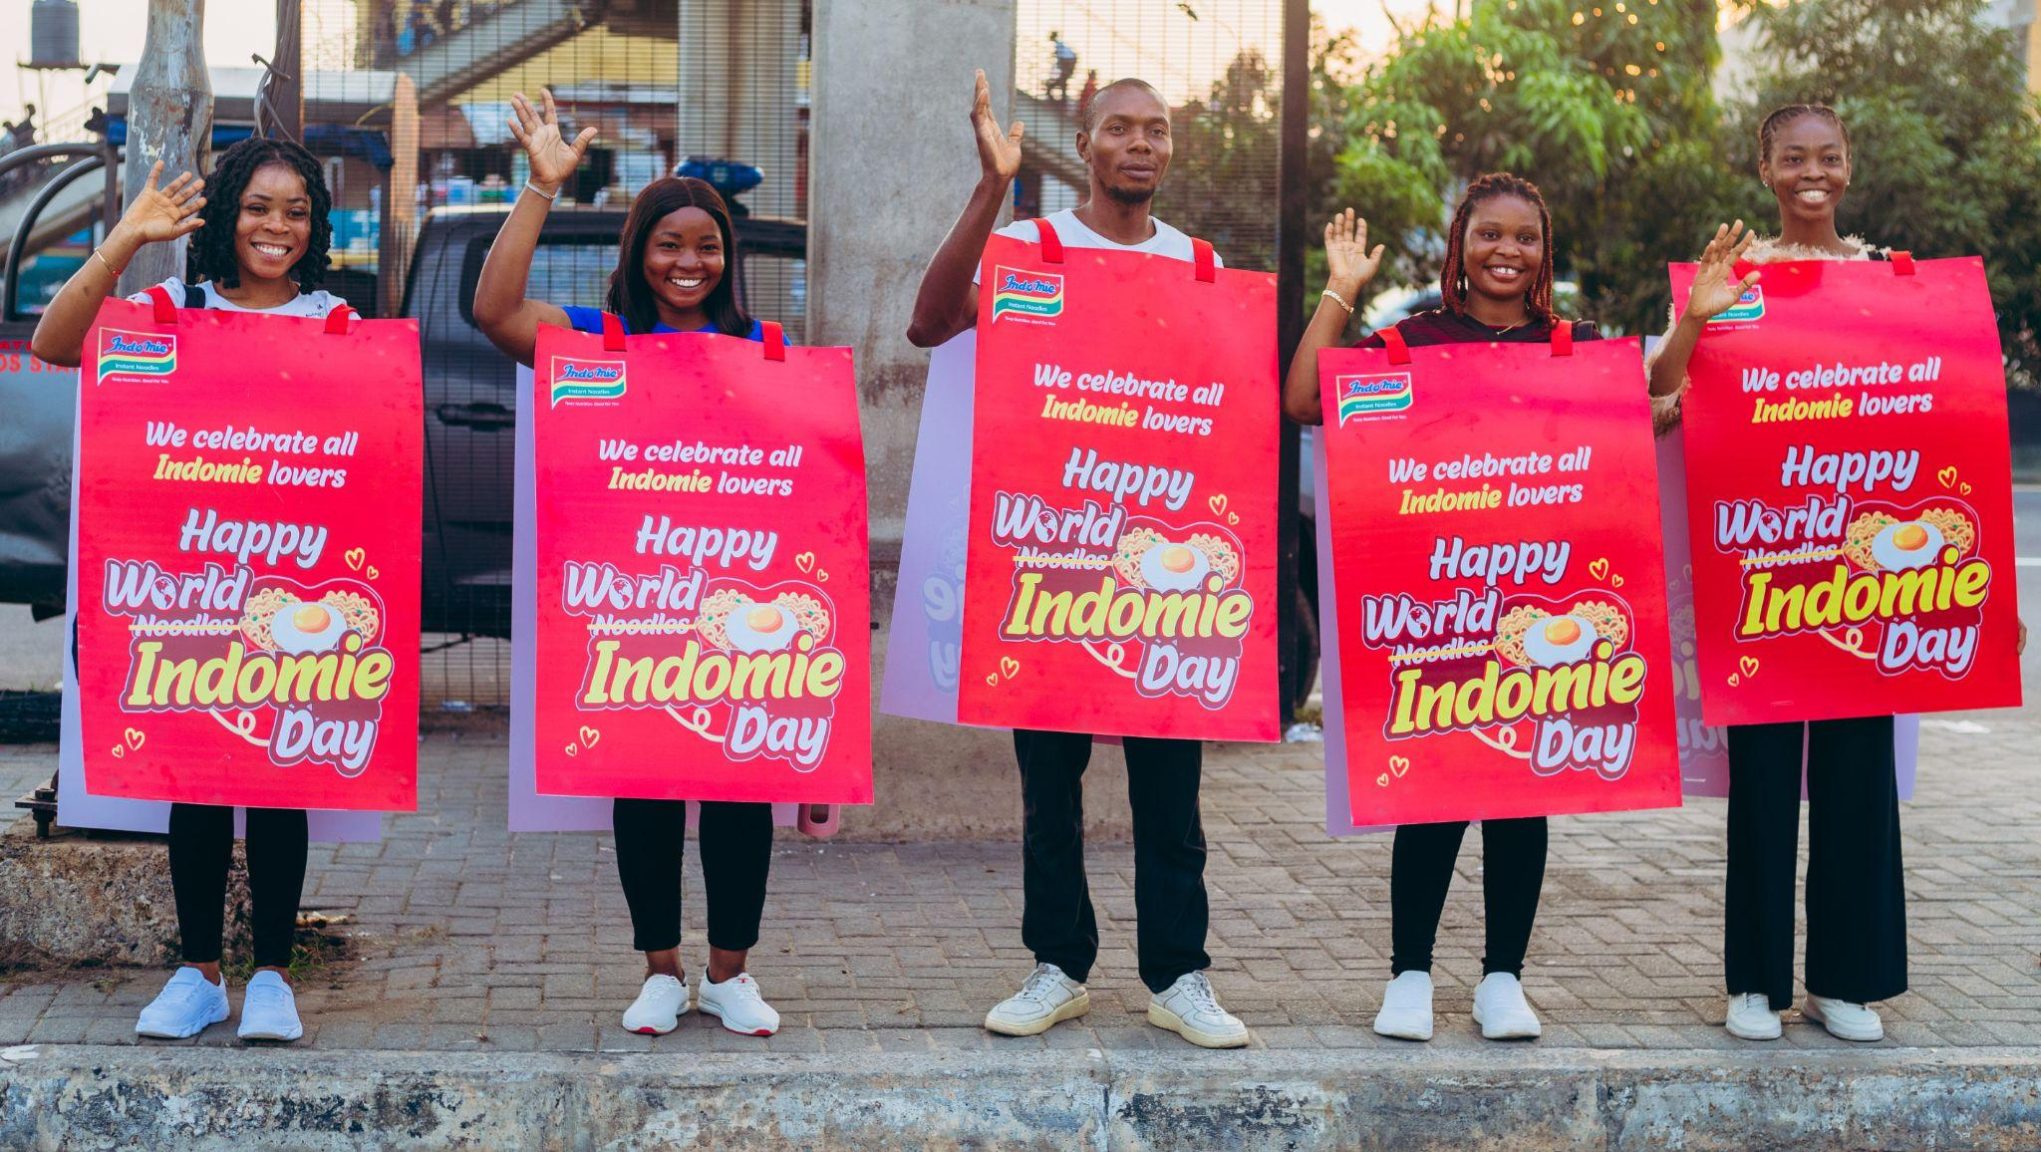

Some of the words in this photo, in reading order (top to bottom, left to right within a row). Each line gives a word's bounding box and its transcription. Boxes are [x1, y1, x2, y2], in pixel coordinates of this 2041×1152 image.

[1034, 363, 1071, 389] We
[1077, 370, 1188, 401] celebrate
[1192, 383, 1224, 406] all
[1742, 368, 1779, 392] We
[1785, 361, 1902, 390] celebrate
[1908, 357, 1941, 381] all
[1041, 394, 1138, 427] Indomie
[1142, 406, 1212, 436] lovers
[1752, 393, 1852, 423] Indomie
[1858, 392, 1932, 416] lovers
[146, 421, 185, 447] We
[192, 426, 316, 454] celebrate
[323, 431, 358, 456] all
[599, 440, 637, 461] We
[644, 441, 763, 465] celebrate
[769, 445, 802, 467] all
[154, 454, 262, 484] Indomie
[268, 459, 346, 488] lovers
[608, 466, 712, 492] Indomie
[718, 471, 792, 495] lovers
[1062, 447, 1194, 511] Happy
[1389, 458, 1426, 483] We
[1433, 451, 1551, 481] celebrate
[1558, 446, 1591, 471] all
[1781, 444, 1920, 492] Happy
[995, 496, 1124, 547] World
[1399, 484, 1502, 515] Indomie
[1508, 482, 1583, 507] lovers
[1718, 496, 1848, 546] World
[179, 508, 327, 568] Happy
[636, 515, 777, 570] Happy
[1018, 548, 1108, 571] Noodles
[1429, 537, 1571, 586] Happy
[1744, 542, 1837, 571] Noodles
[108, 562, 249, 610] World
[566, 566, 703, 610] World
[1006, 573, 1251, 638] Indomie
[1742, 546, 1991, 635] Indomie
[134, 614, 234, 636] Noodles
[592, 614, 690, 636] Noodles
[1366, 587, 1497, 641] World
[128, 630, 392, 705] Indomie
[584, 632, 843, 704] Indomie
[1392, 637, 1489, 665] Noodles
[1882, 621, 1976, 674] Day
[1142, 643, 1237, 701] Day
[1390, 641, 1646, 734] Indomie
[276, 708, 374, 769] Day
[730, 705, 828, 764] Day
[1537, 718, 1633, 770] Day
